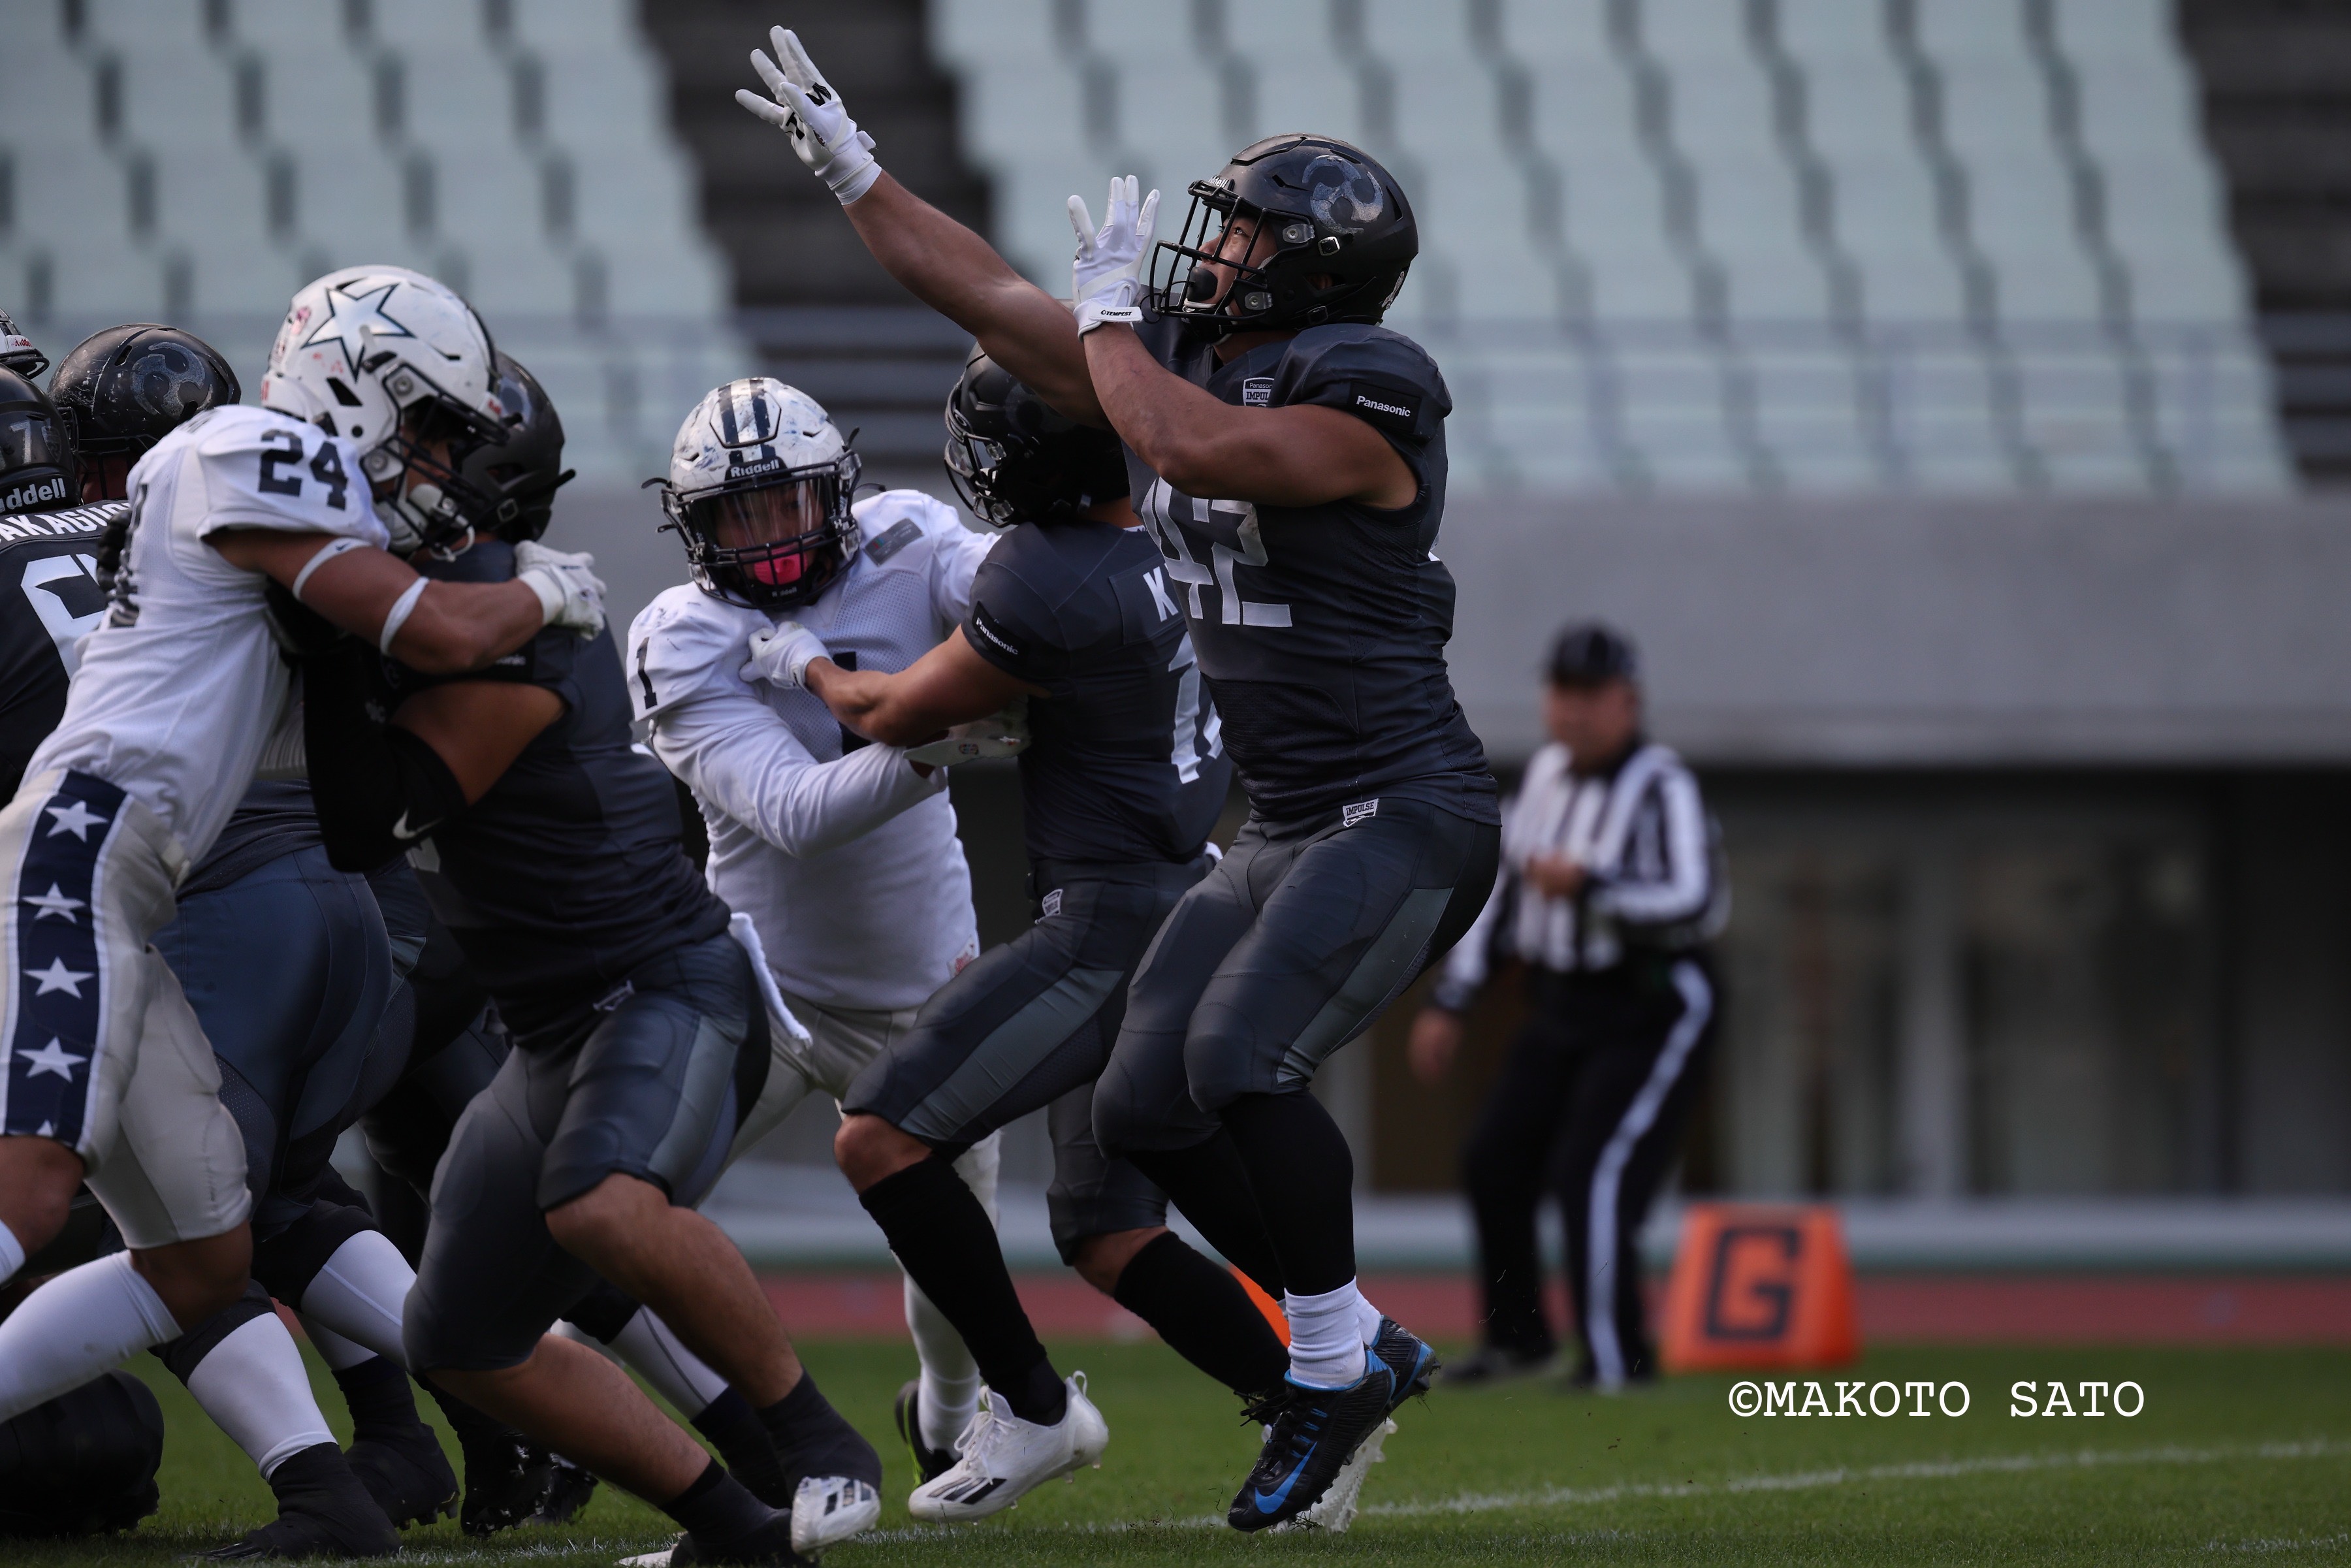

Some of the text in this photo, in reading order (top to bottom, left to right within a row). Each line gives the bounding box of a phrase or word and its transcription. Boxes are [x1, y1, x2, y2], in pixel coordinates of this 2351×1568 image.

[1356, 395, 1411, 417] Panasonic
[258, 429, 348, 511] 24
[730, 459, 780, 477] Riddell
[1141, 476, 1292, 628] 42
[976, 617, 1018, 654] Panasonic
[636, 637, 658, 710] 1
[1346, 801, 1375, 816] IMPULSE
[1705, 1226, 1800, 1342] G
